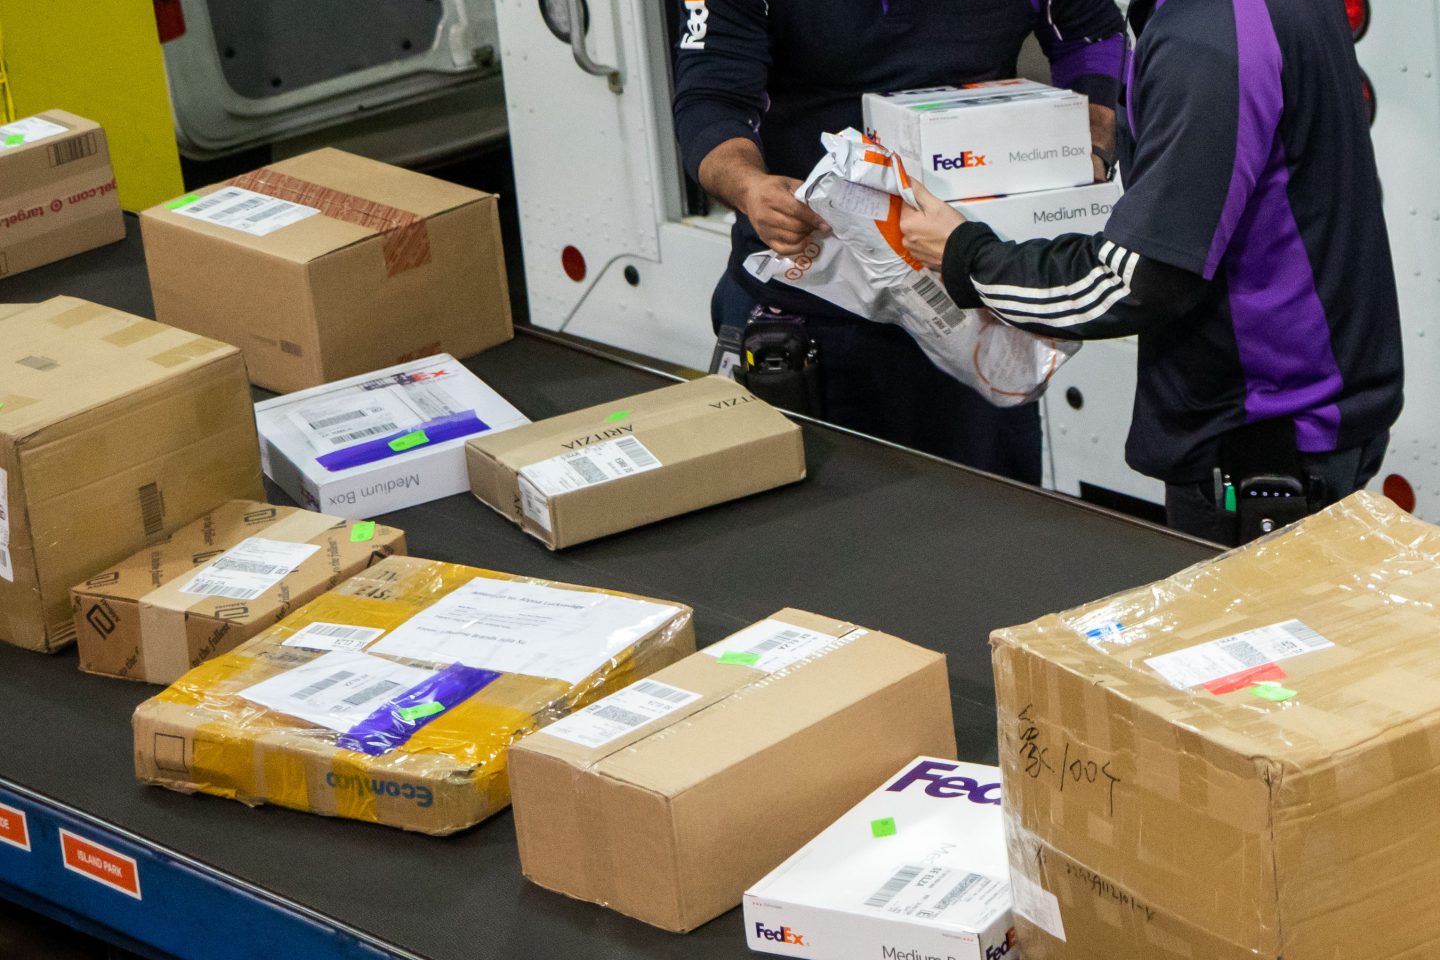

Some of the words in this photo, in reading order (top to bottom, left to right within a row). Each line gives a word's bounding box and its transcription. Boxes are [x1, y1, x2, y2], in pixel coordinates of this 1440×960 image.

[932, 150, 987, 171] FedEx
[1008, 148, 1058, 163] Medium
[1062, 145, 1086, 158] Box
[1033, 205, 1087, 224] Medium
[561, 423, 633, 451] ARITZIA
[329, 490, 357, 506] Box
[361, 473, 420, 498] Medium
[77, 849, 103, 869] ISLAND
[103, 861, 123, 878] PARK
[755, 921, 805, 946] FedEx
